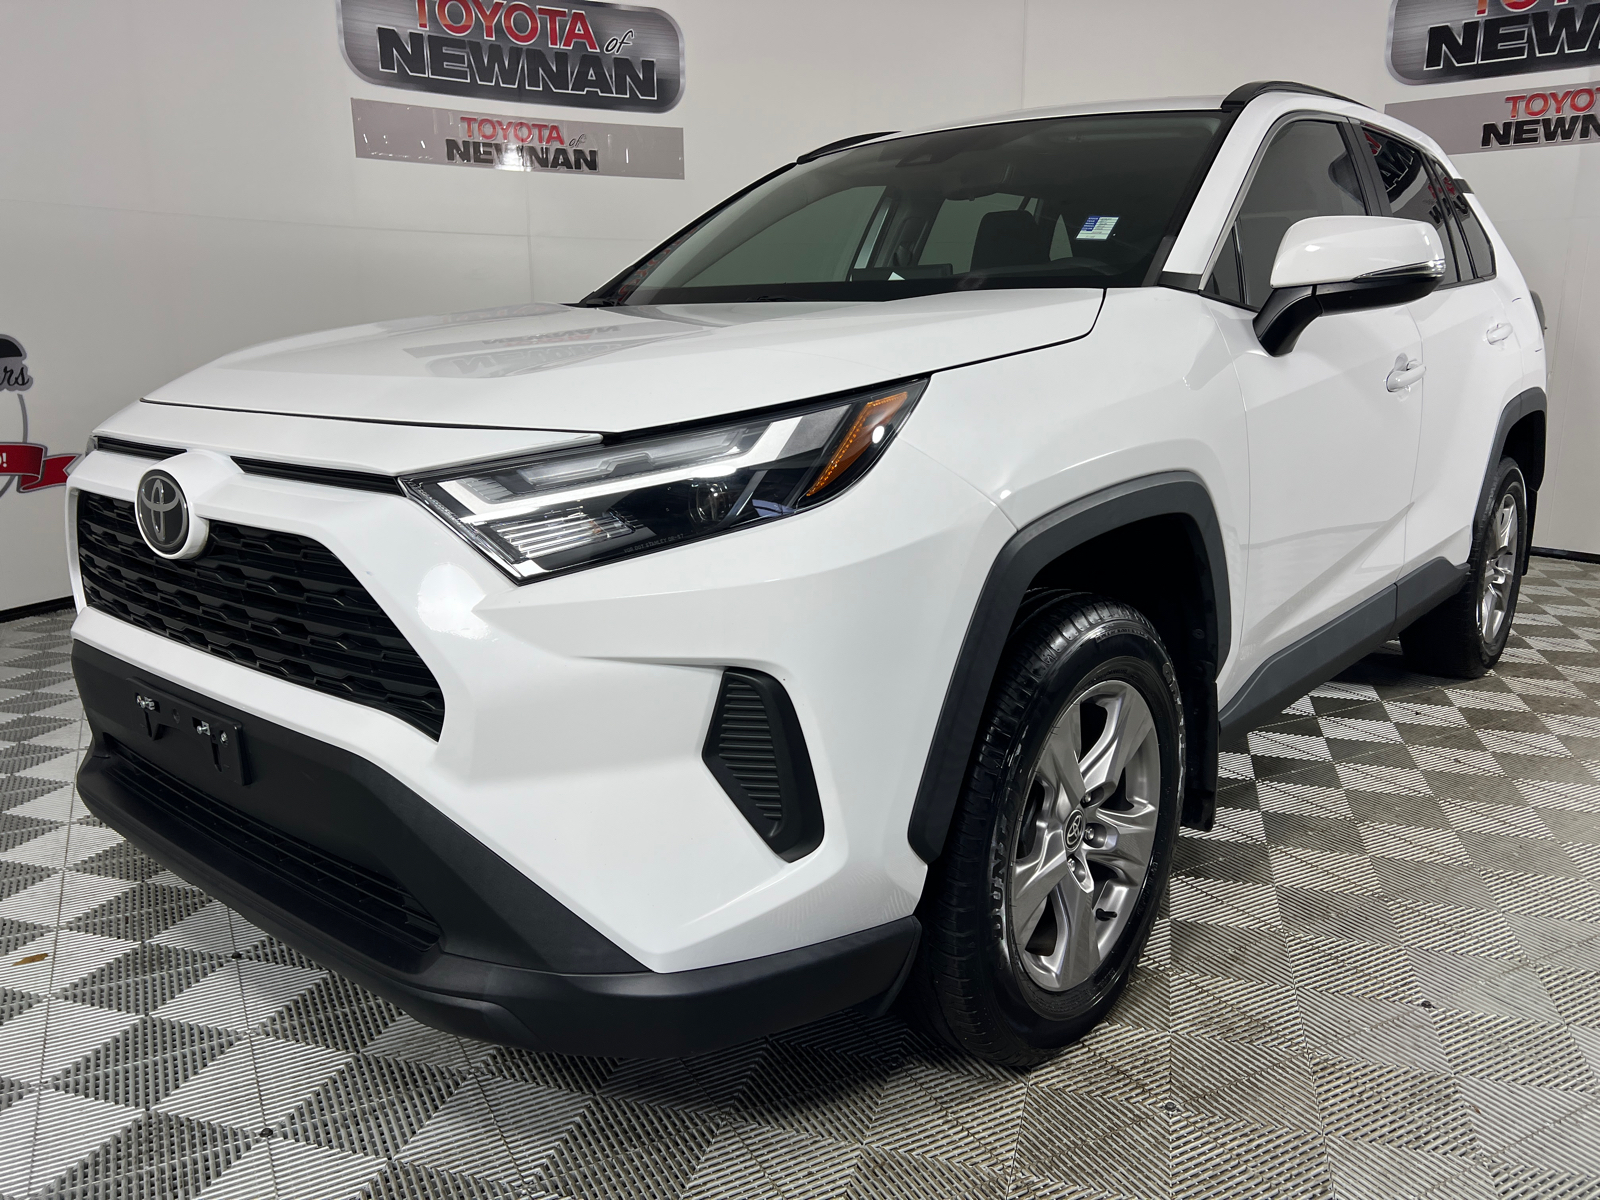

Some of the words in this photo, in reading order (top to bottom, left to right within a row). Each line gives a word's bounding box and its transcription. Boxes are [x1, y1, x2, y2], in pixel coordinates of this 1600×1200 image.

[415, 0, 600, 52] TOYOTA
[603, 29, 635, 55] of
[1423, 3, 1600, 71] NEW
[377, 26, 657, 100] NEWNAN
[1505, 86, 1600, 119] TOYO
[460, 116, 565, 146] TOYOTA
